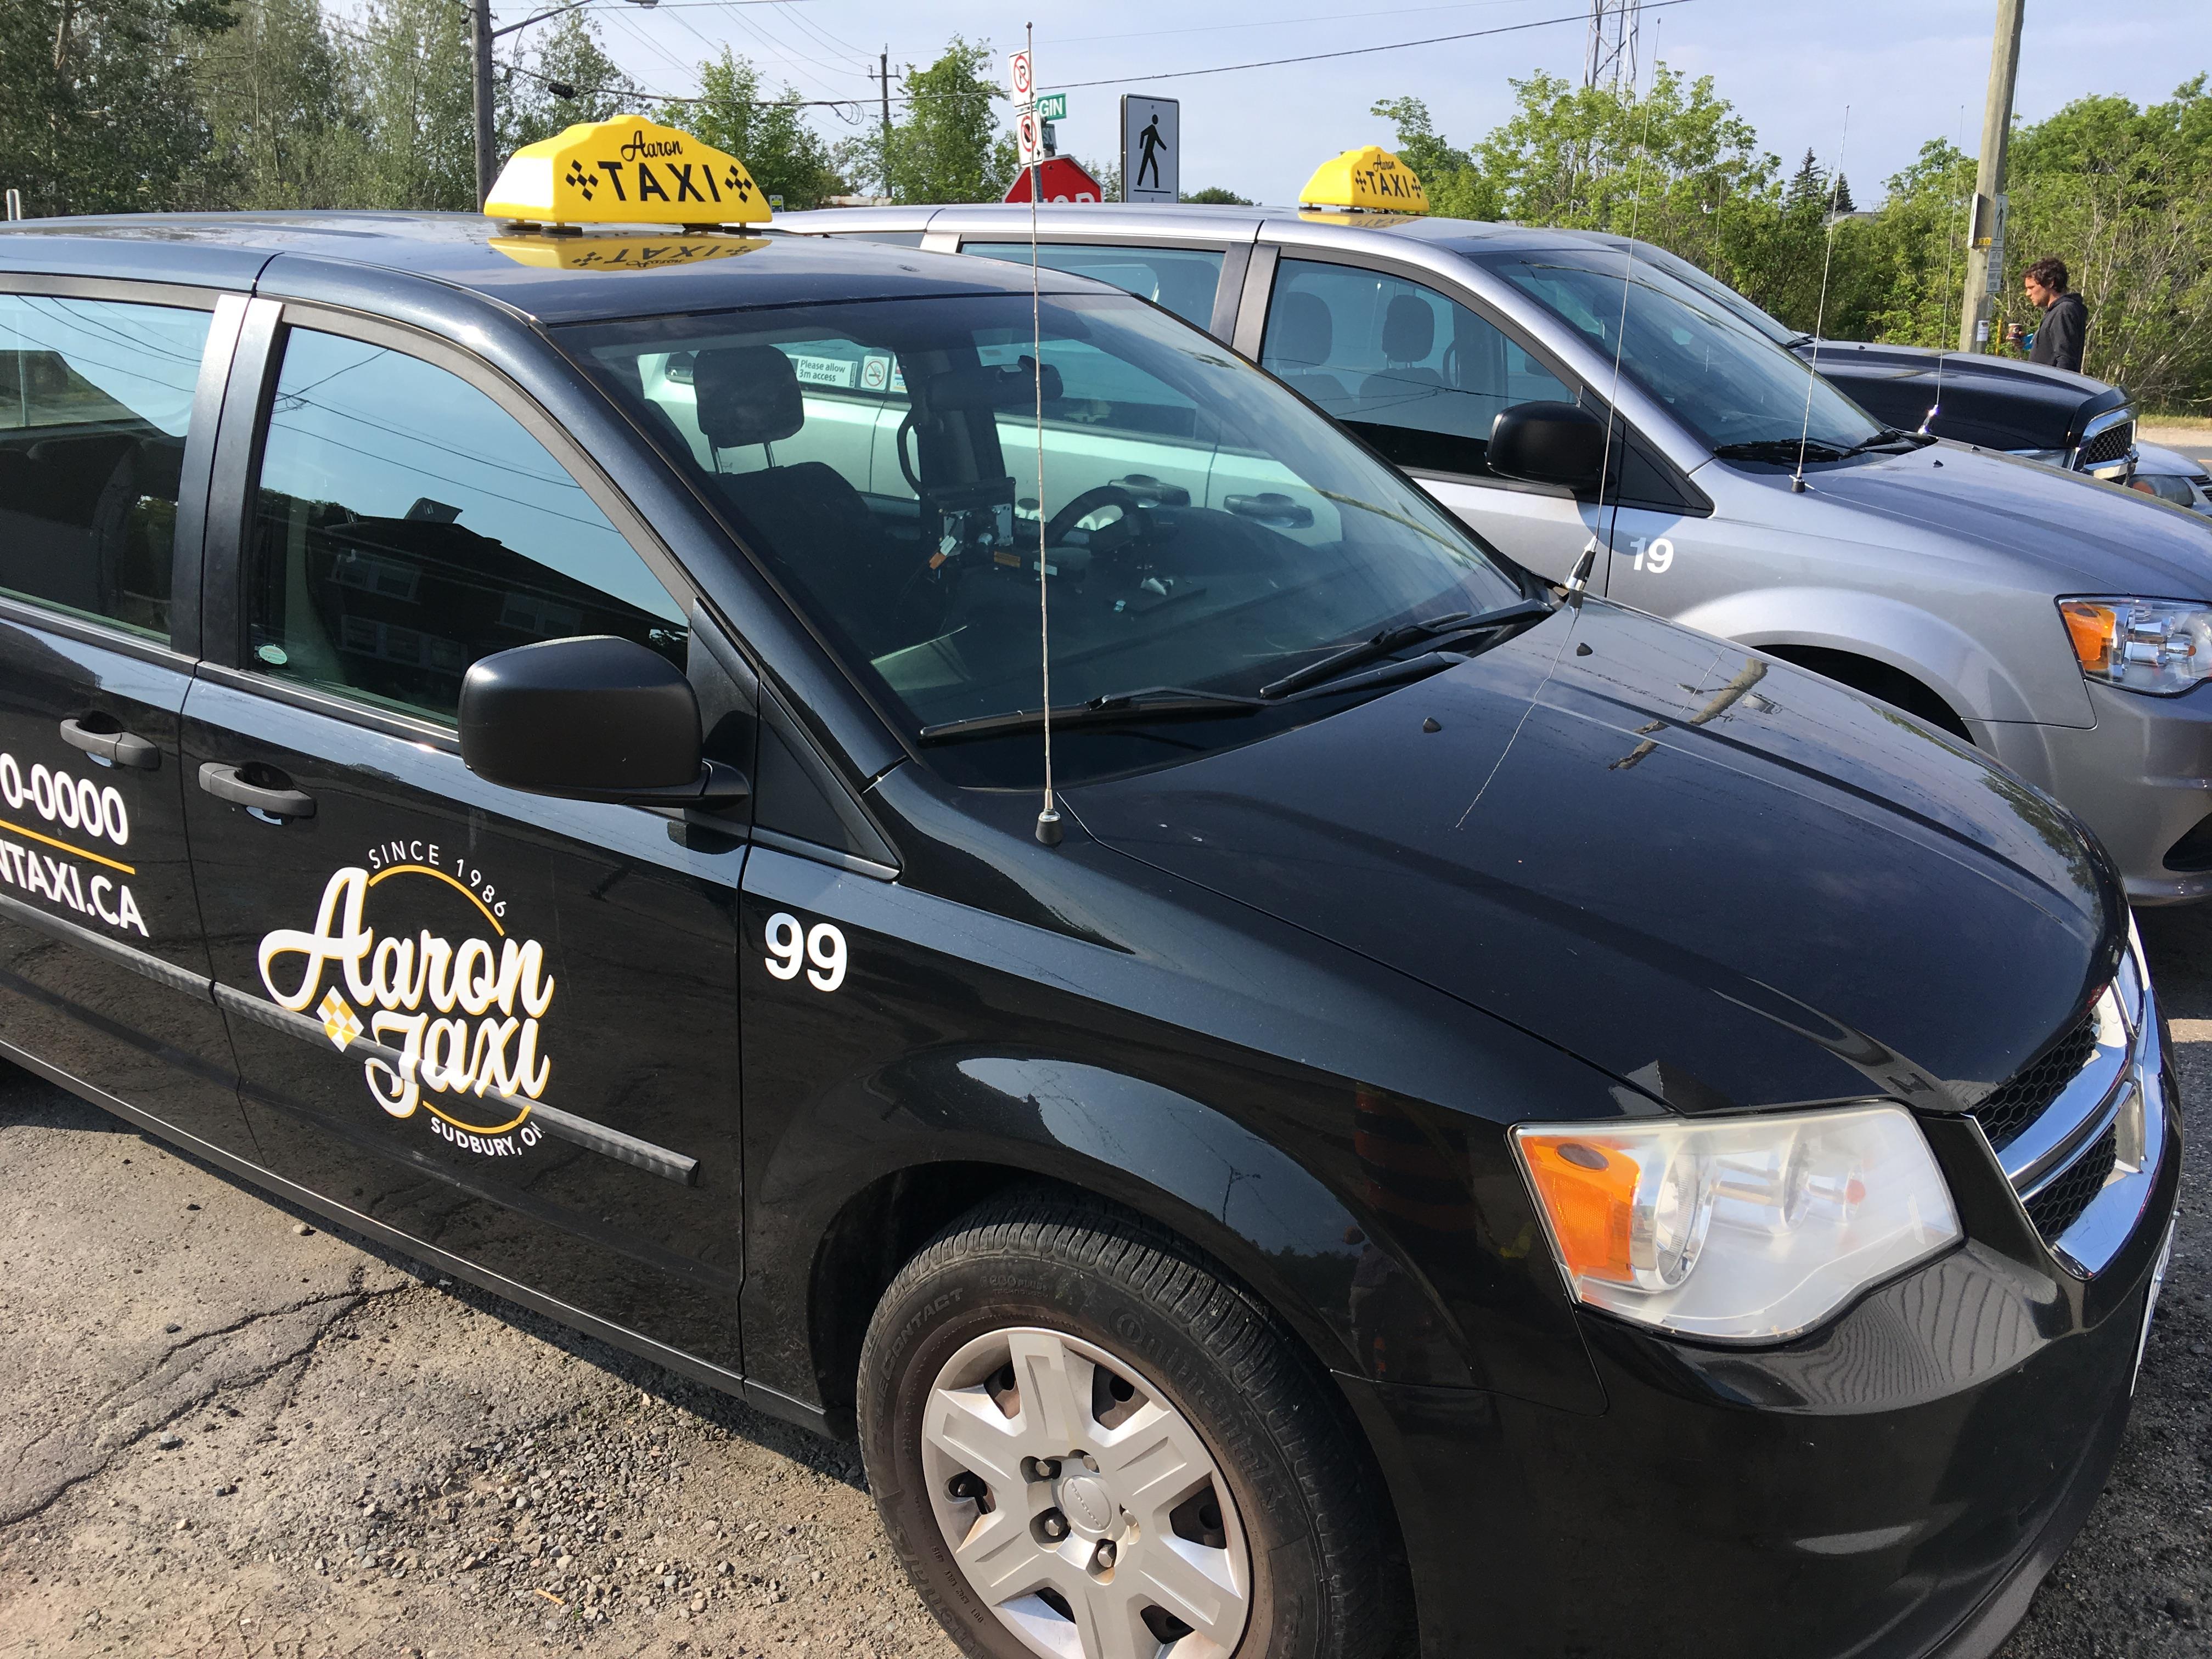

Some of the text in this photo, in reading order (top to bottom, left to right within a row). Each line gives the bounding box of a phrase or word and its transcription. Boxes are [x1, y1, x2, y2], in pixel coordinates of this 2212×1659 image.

[621, 130, 683, 162] Aaron
[1373, 154, 1395, 172] Aaron
[597, 161, 721, 202] TAXI
[1365, 171, 1411, 198] TAXI
[799, 369, 836, 382] 3m access
[801, 360, 846, 373] Please allow
[1630, 537, 1674, 573] 19
[369, 840, 507, 917] SINCE 1986
[258, 867, 554, 1018] Aaron
[765, 912, 847, 992] 99
[364, 1010, 550, 1118] Taxi
[431, 1117, 523, 1156] SUDBURY,
